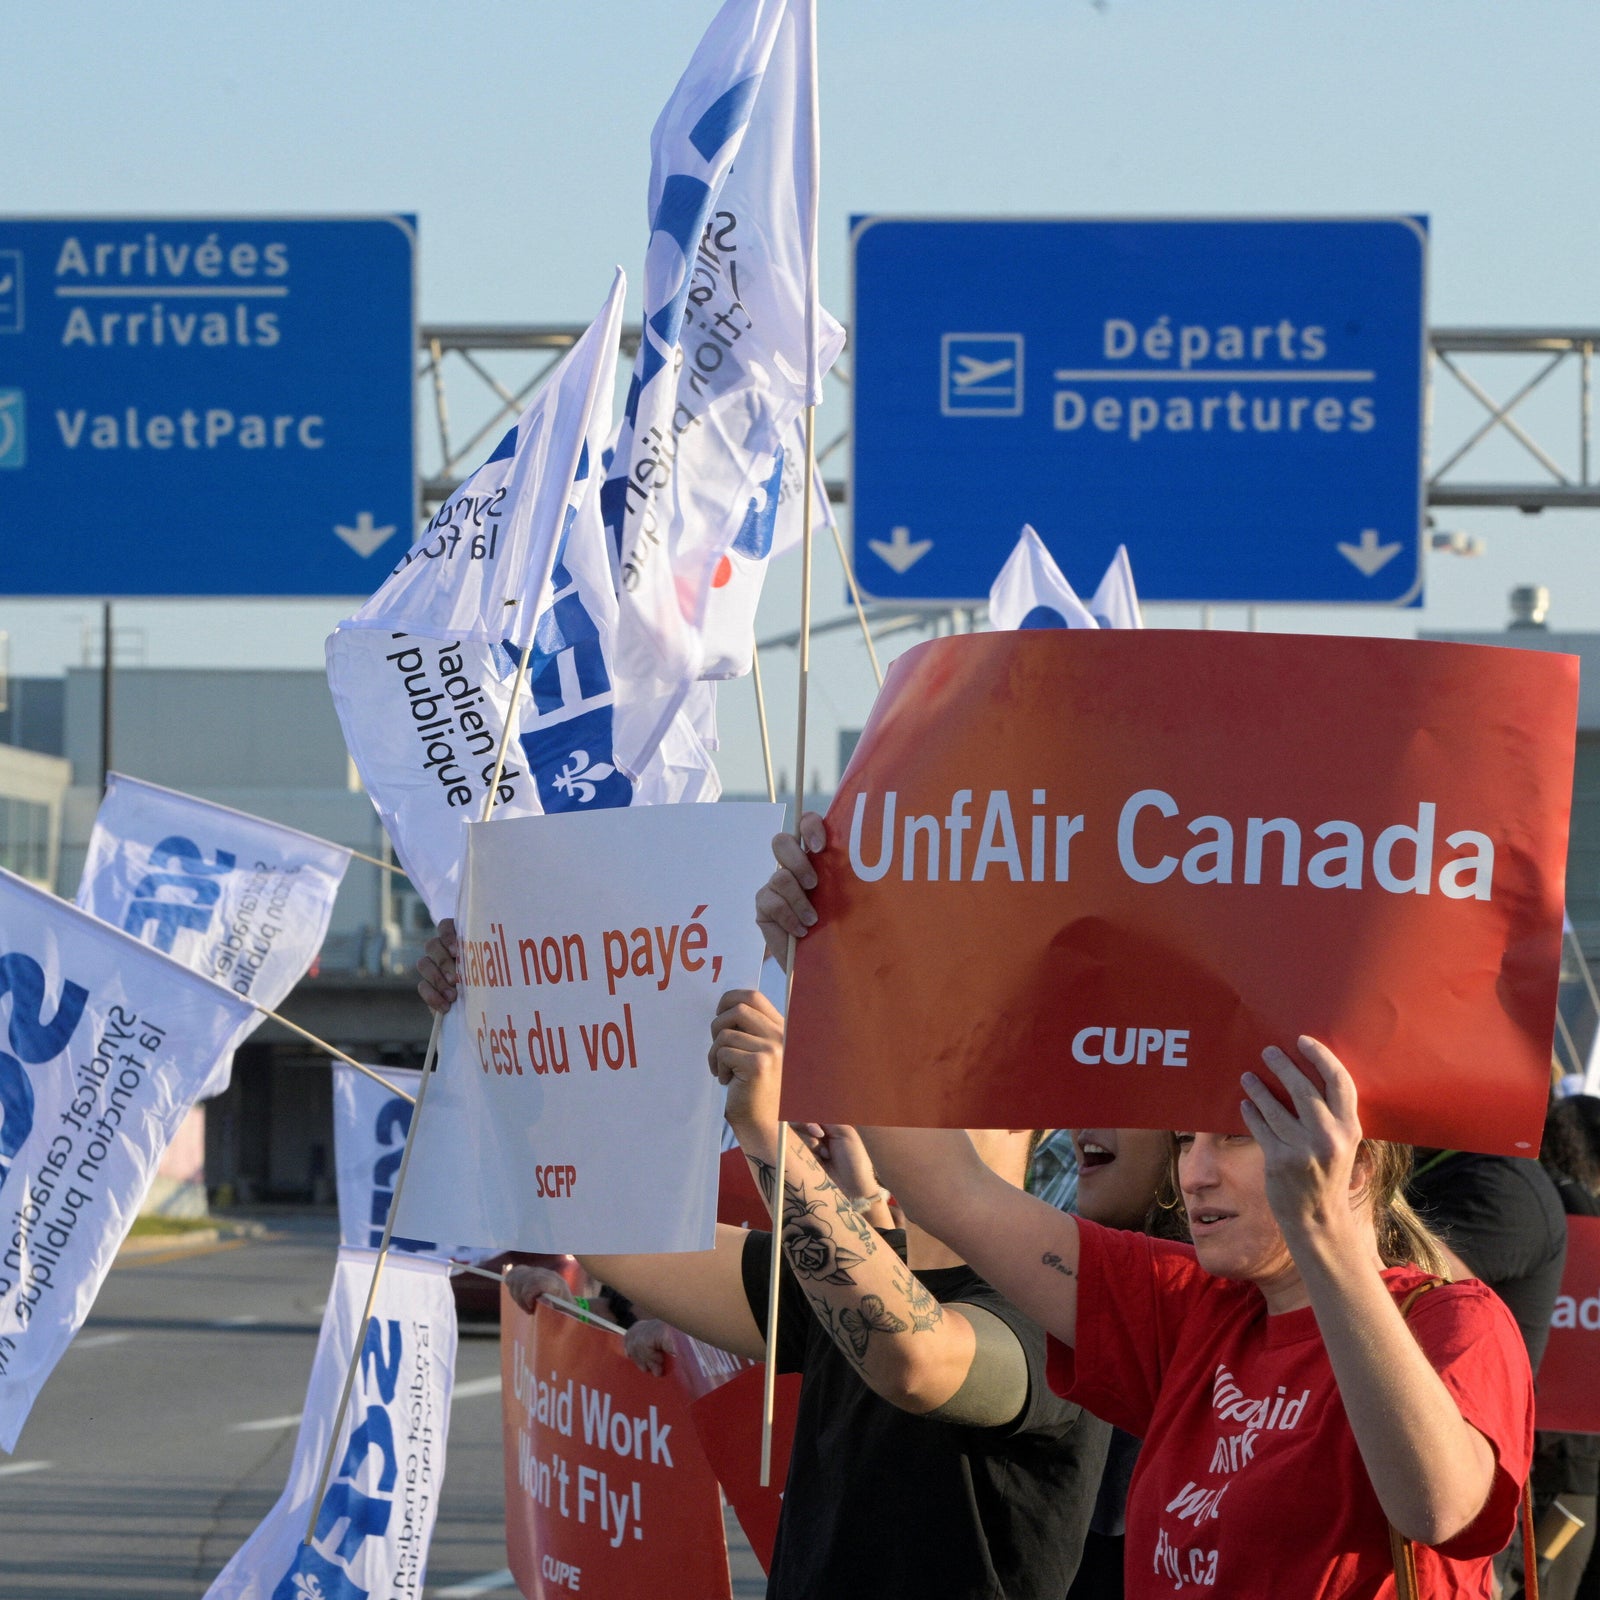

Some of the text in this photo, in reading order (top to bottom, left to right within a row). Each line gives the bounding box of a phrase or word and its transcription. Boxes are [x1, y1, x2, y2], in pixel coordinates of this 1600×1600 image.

[56, 233, 289, 276] Arrivées
[62, 303, 280, 345] Arrivals
[1103, 316, 1326, 369] Départs
[56, 408, 324, 448] ValetParc
[1053, 391, 1375, 441] Departures
[386, 647, 473, 808] publique
[848, 788, 1495, 902] UnfAir Canada
[518, 933, 588, 986] non
[603, 904, 724, 996] payé,
[477, 1003, 638, 1076] c'est du vol
[1071, 1026, 1190, 1067] CUPE
[535, 1165, 577, 1198] SCFP
[580, 1384, 674, 1468] Work
[518, 1427, 643, 1548] Won't Fly!
[542, 1554, 581, 1592] CUPE
